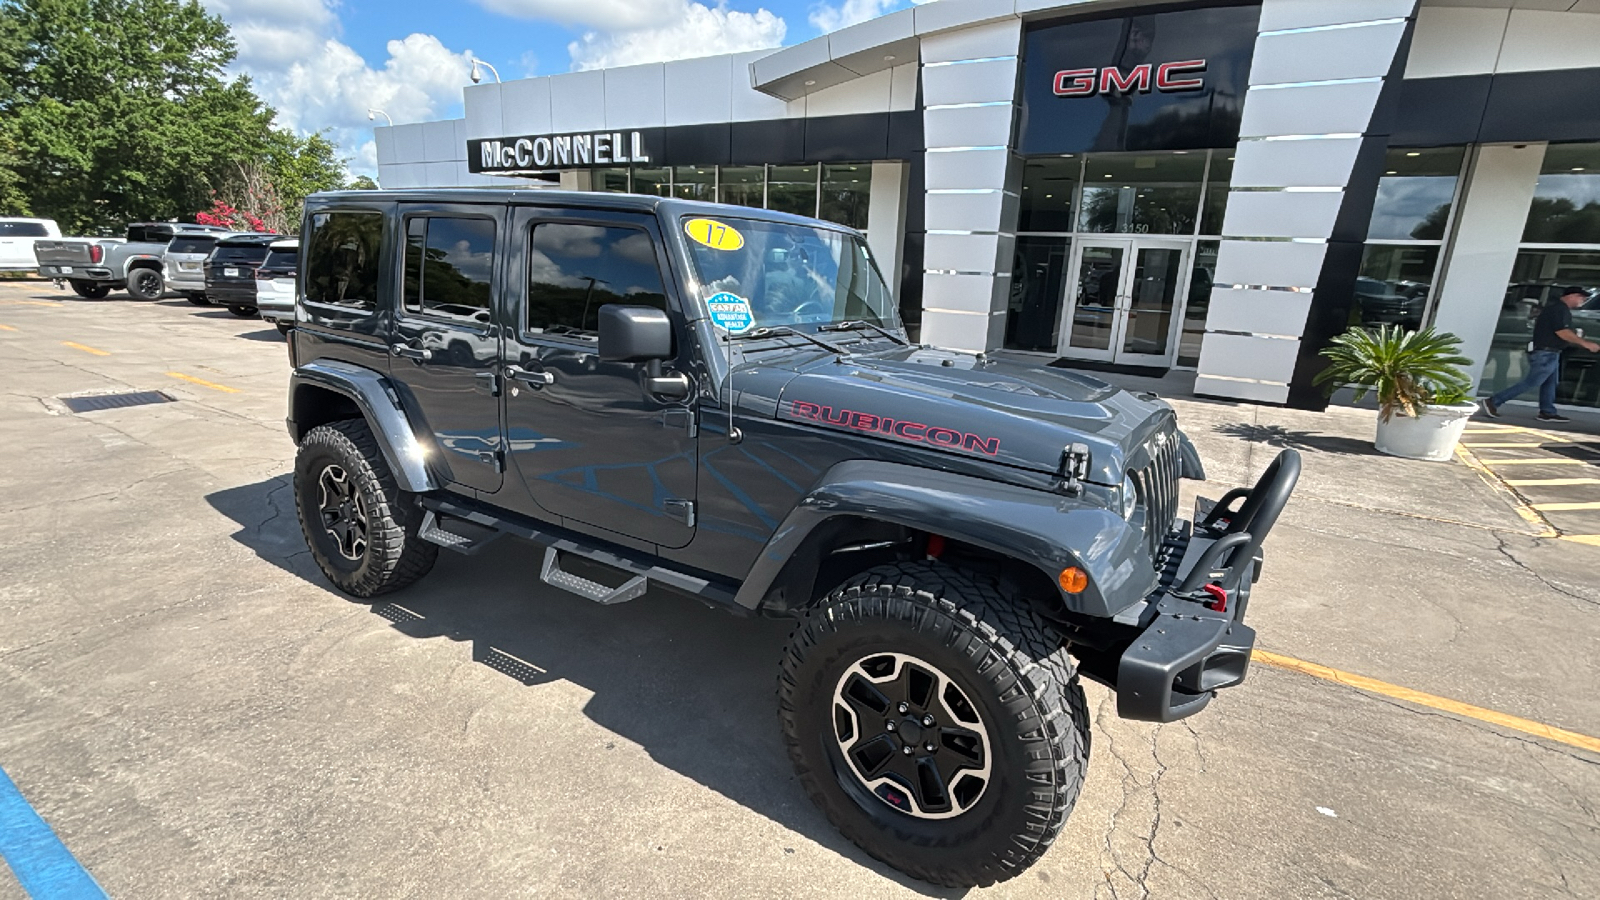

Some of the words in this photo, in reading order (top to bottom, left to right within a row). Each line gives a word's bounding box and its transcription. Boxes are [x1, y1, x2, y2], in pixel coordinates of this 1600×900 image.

[1053, 59, 1206, 96] GMC
[481, 132, 648, 168] McCONNELL
[706, 224, 726, 245] 17
[1121, 223, 1149, 234] 3150
[716, 312, 748, 321] ADVANTAGE
[791, 400, 1000, 456] RUBICON
